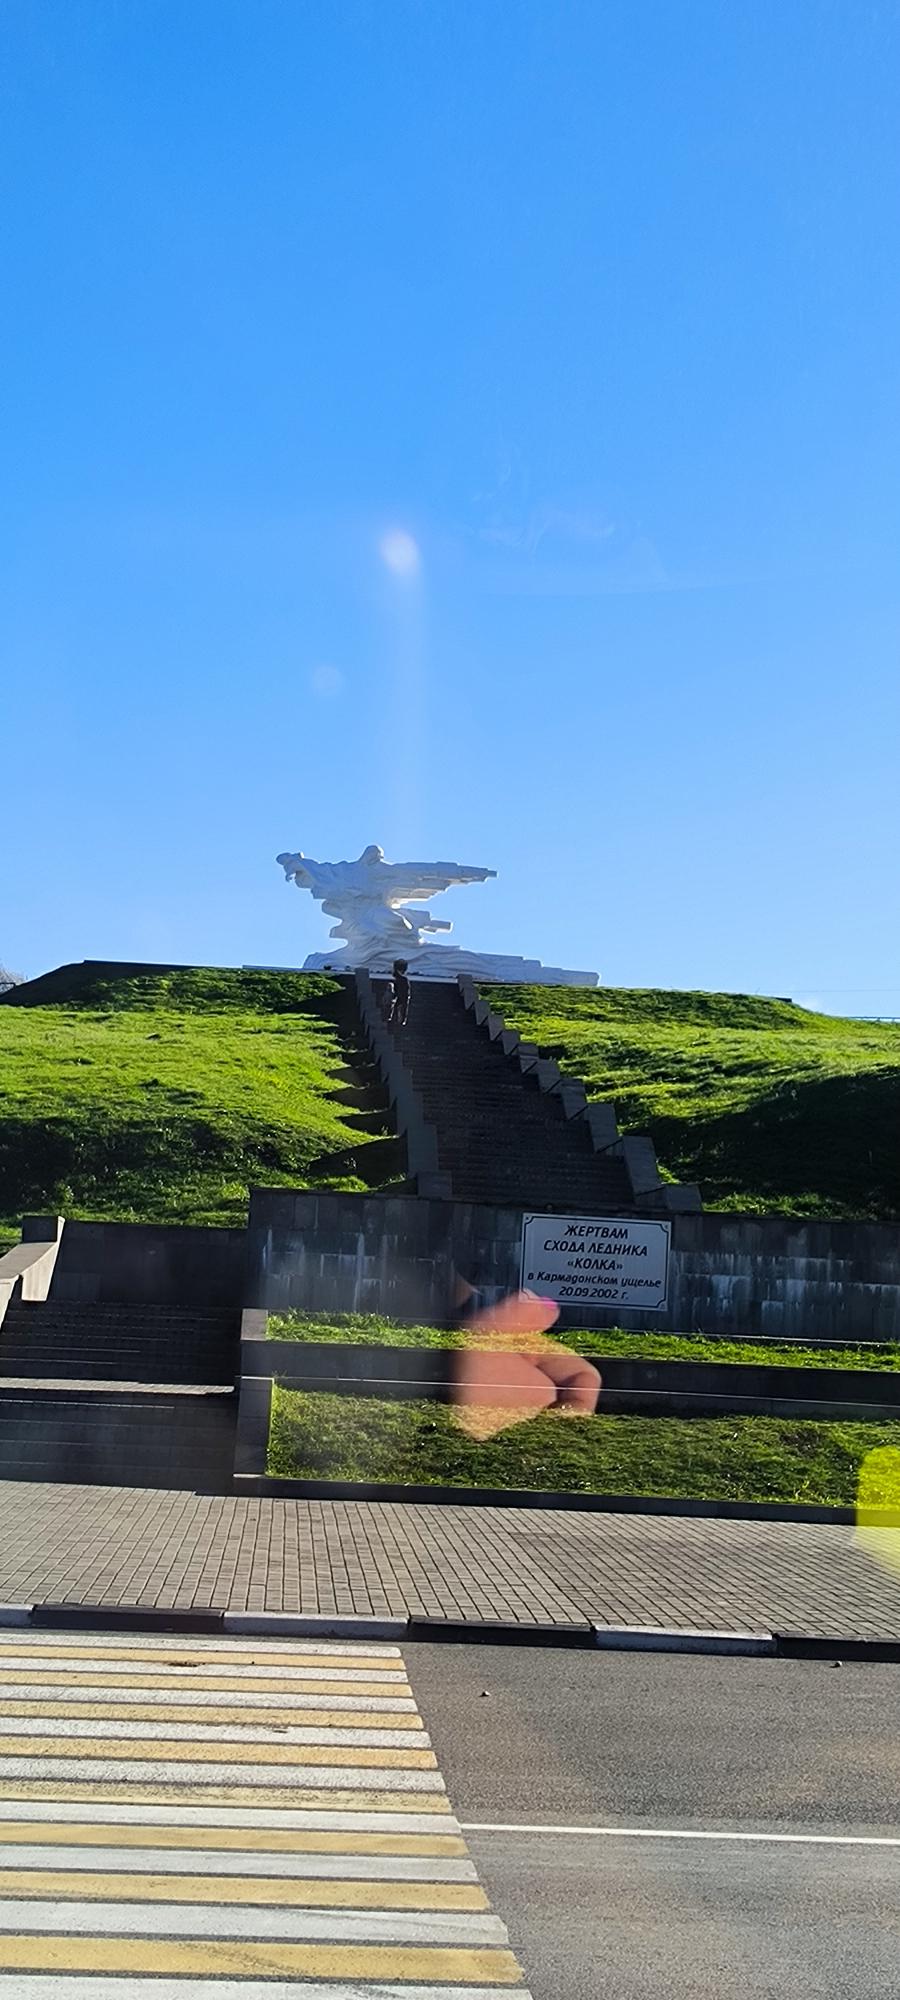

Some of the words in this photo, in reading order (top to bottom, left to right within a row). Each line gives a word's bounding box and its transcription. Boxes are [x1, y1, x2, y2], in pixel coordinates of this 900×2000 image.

[564, 1225, 629, 1239] ЖЕРТВАМ
[543, 1240, 585, 1253] СХОДА
[587, 1243, 648, 1256] ЛЕДНИКА
[567, 1258, 623, 1271] «КОЛКА»
[527, 1272, 534, 1281] в
[536, 1271, 618, 1285] Кармадонском
[621, 1278, 662, 1288] ущелье
[559, 1286, 618, 1300] 20.09.2002
[621, 1291, 629, 1300] г.
